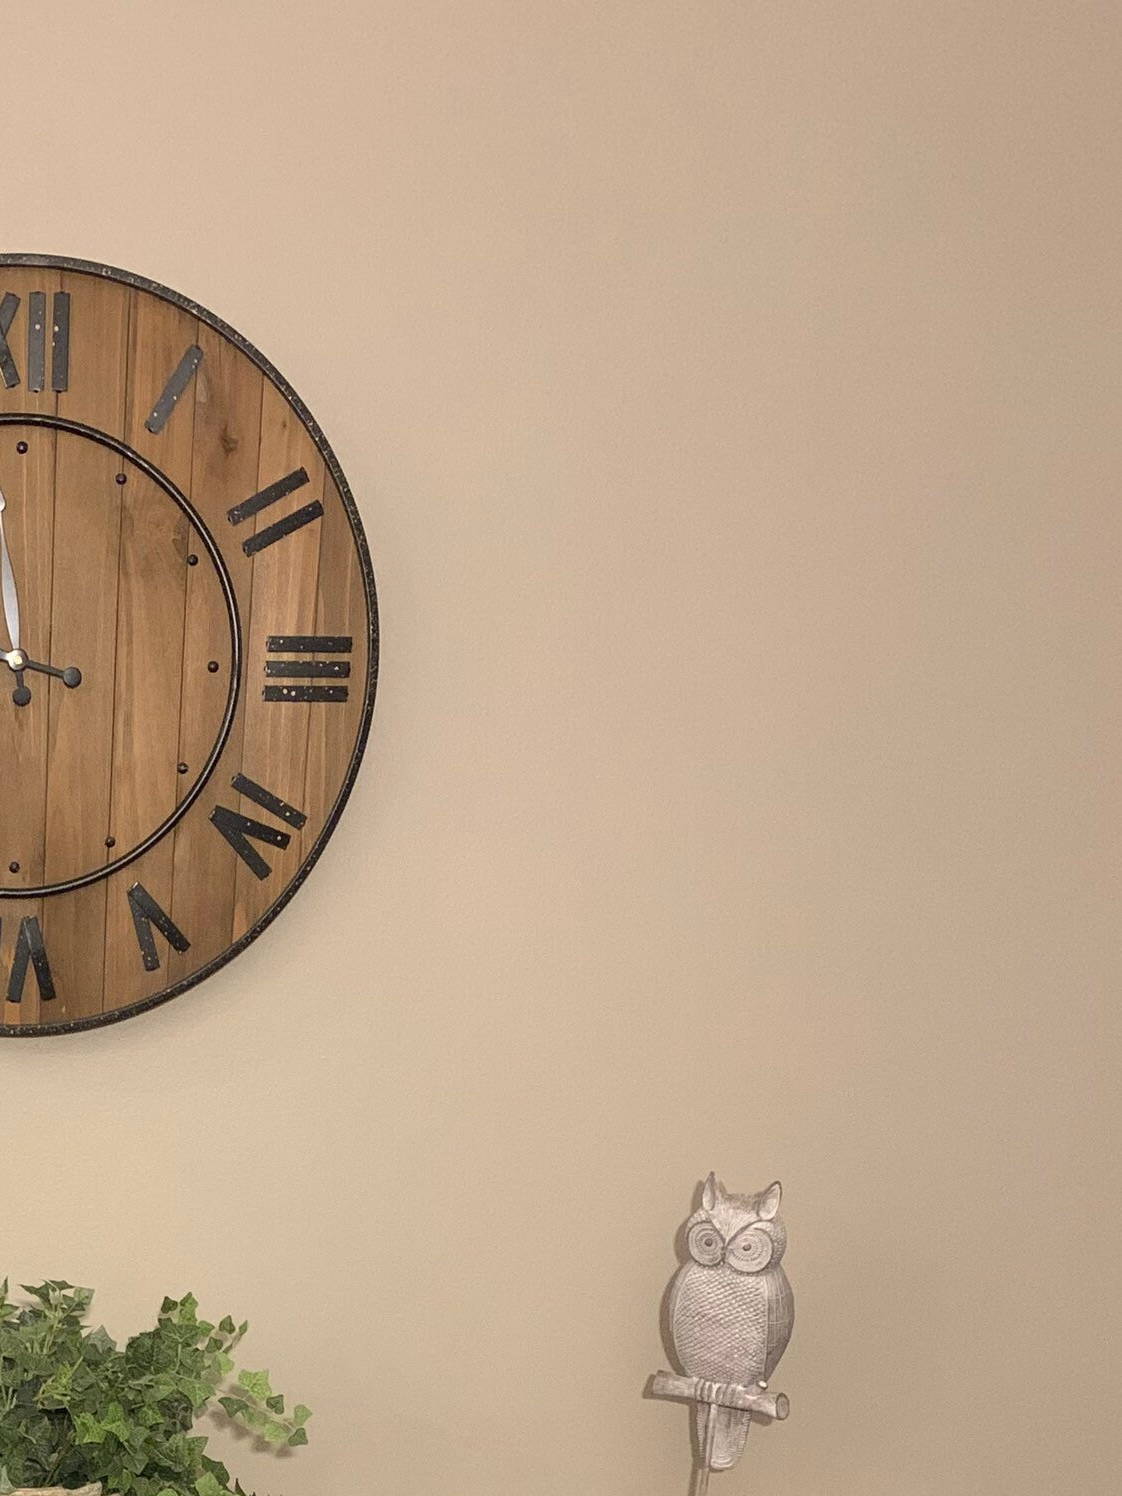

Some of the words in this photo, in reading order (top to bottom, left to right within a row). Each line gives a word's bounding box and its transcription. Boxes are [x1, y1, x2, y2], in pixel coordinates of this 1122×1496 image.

[144, 344, 203, 435] I
[227, 466, 324, 557] II
[262, 635, 353, 702] III
[209, 772, 307, 880] IV
[127, 881, 191, 971] V
